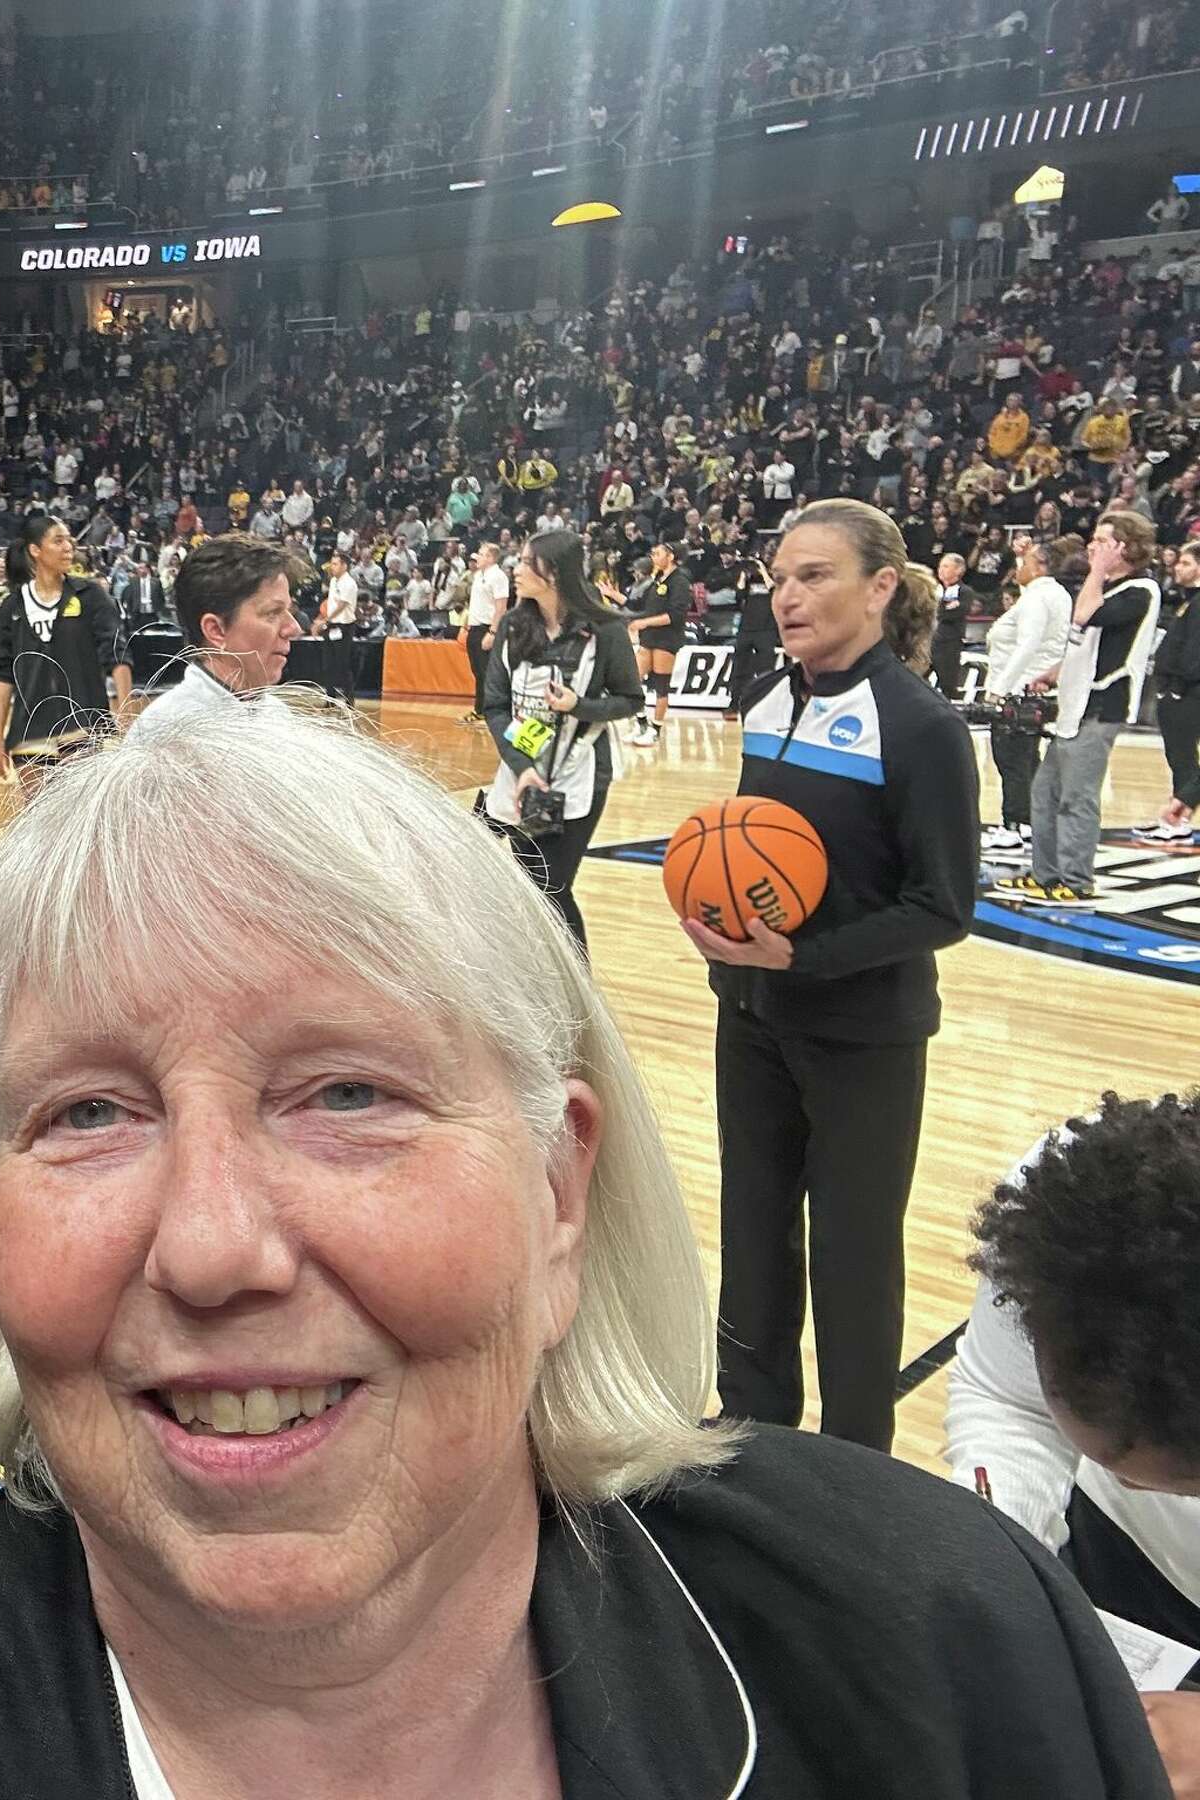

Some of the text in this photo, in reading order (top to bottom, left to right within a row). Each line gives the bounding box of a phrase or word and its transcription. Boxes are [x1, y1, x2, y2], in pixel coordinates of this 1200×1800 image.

[20, 235, 261, 271] COLORADO VS IOWA
[744, 876, 789, 931] Wil
